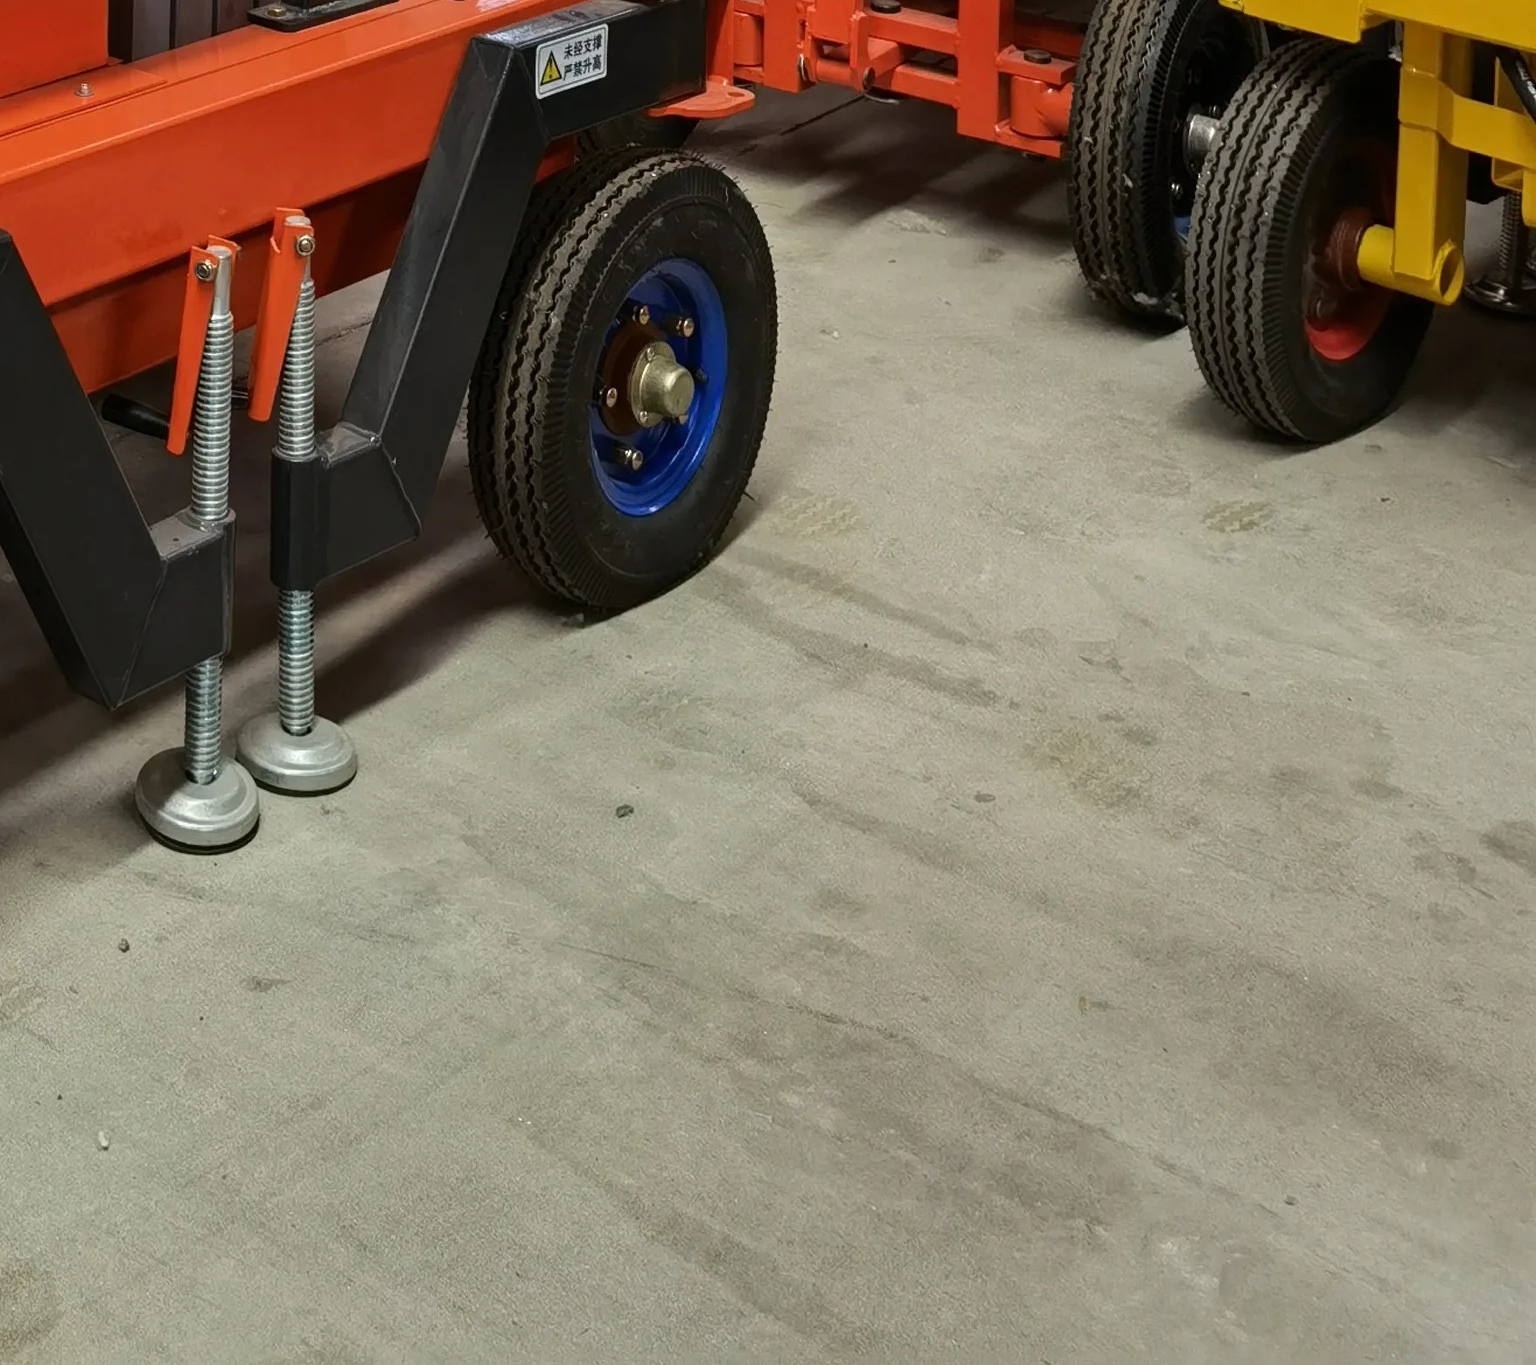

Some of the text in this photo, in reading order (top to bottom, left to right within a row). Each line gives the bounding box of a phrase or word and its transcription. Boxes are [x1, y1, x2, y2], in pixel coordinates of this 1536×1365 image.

[563, 34, 602, 60] 未经支撑
[562, 53, 602, 81] 严禁升高
